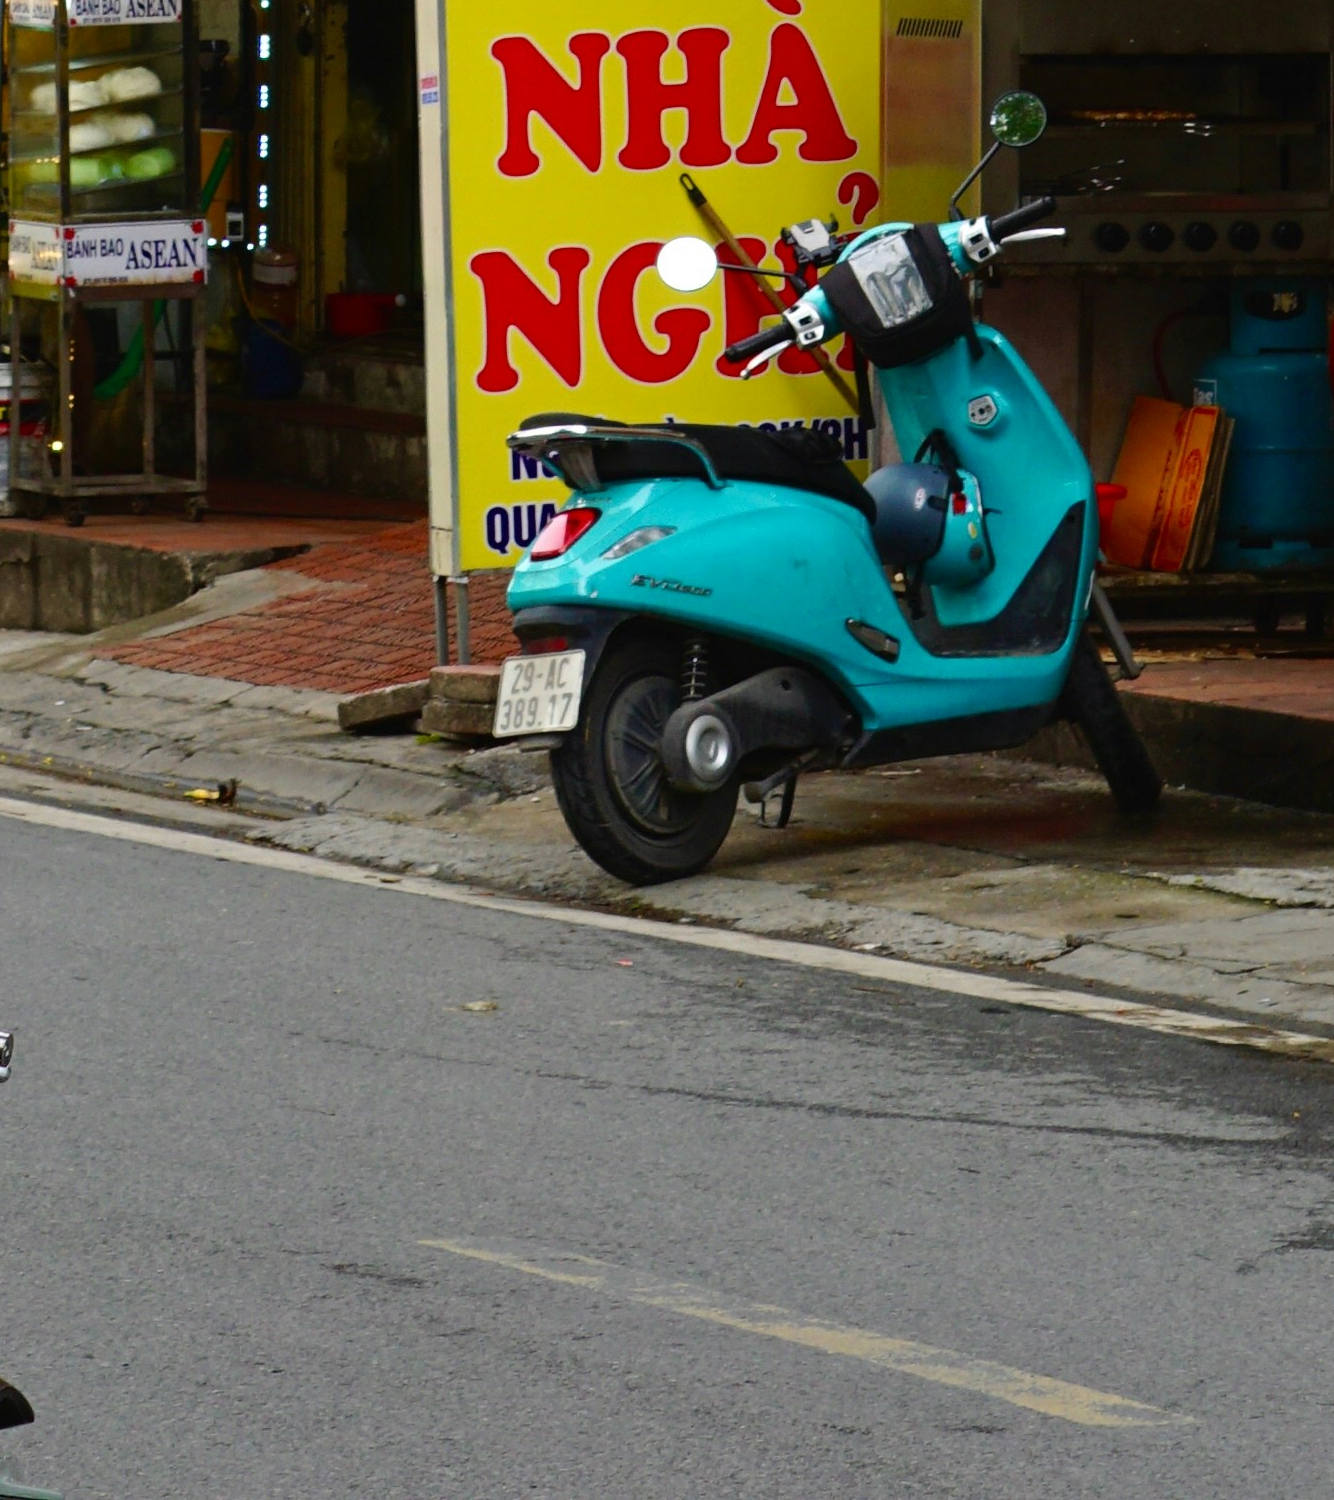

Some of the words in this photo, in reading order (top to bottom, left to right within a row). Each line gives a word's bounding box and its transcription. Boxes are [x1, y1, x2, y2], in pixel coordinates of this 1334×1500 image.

[67, 236, 98, 260] BÁNH
[100, 238, 124, 258] BAO
[126, 238, 200, 271] ASEAN
[511, 658, 571, 695] 29-AC
[500, 693, 575, 732] 389.17
